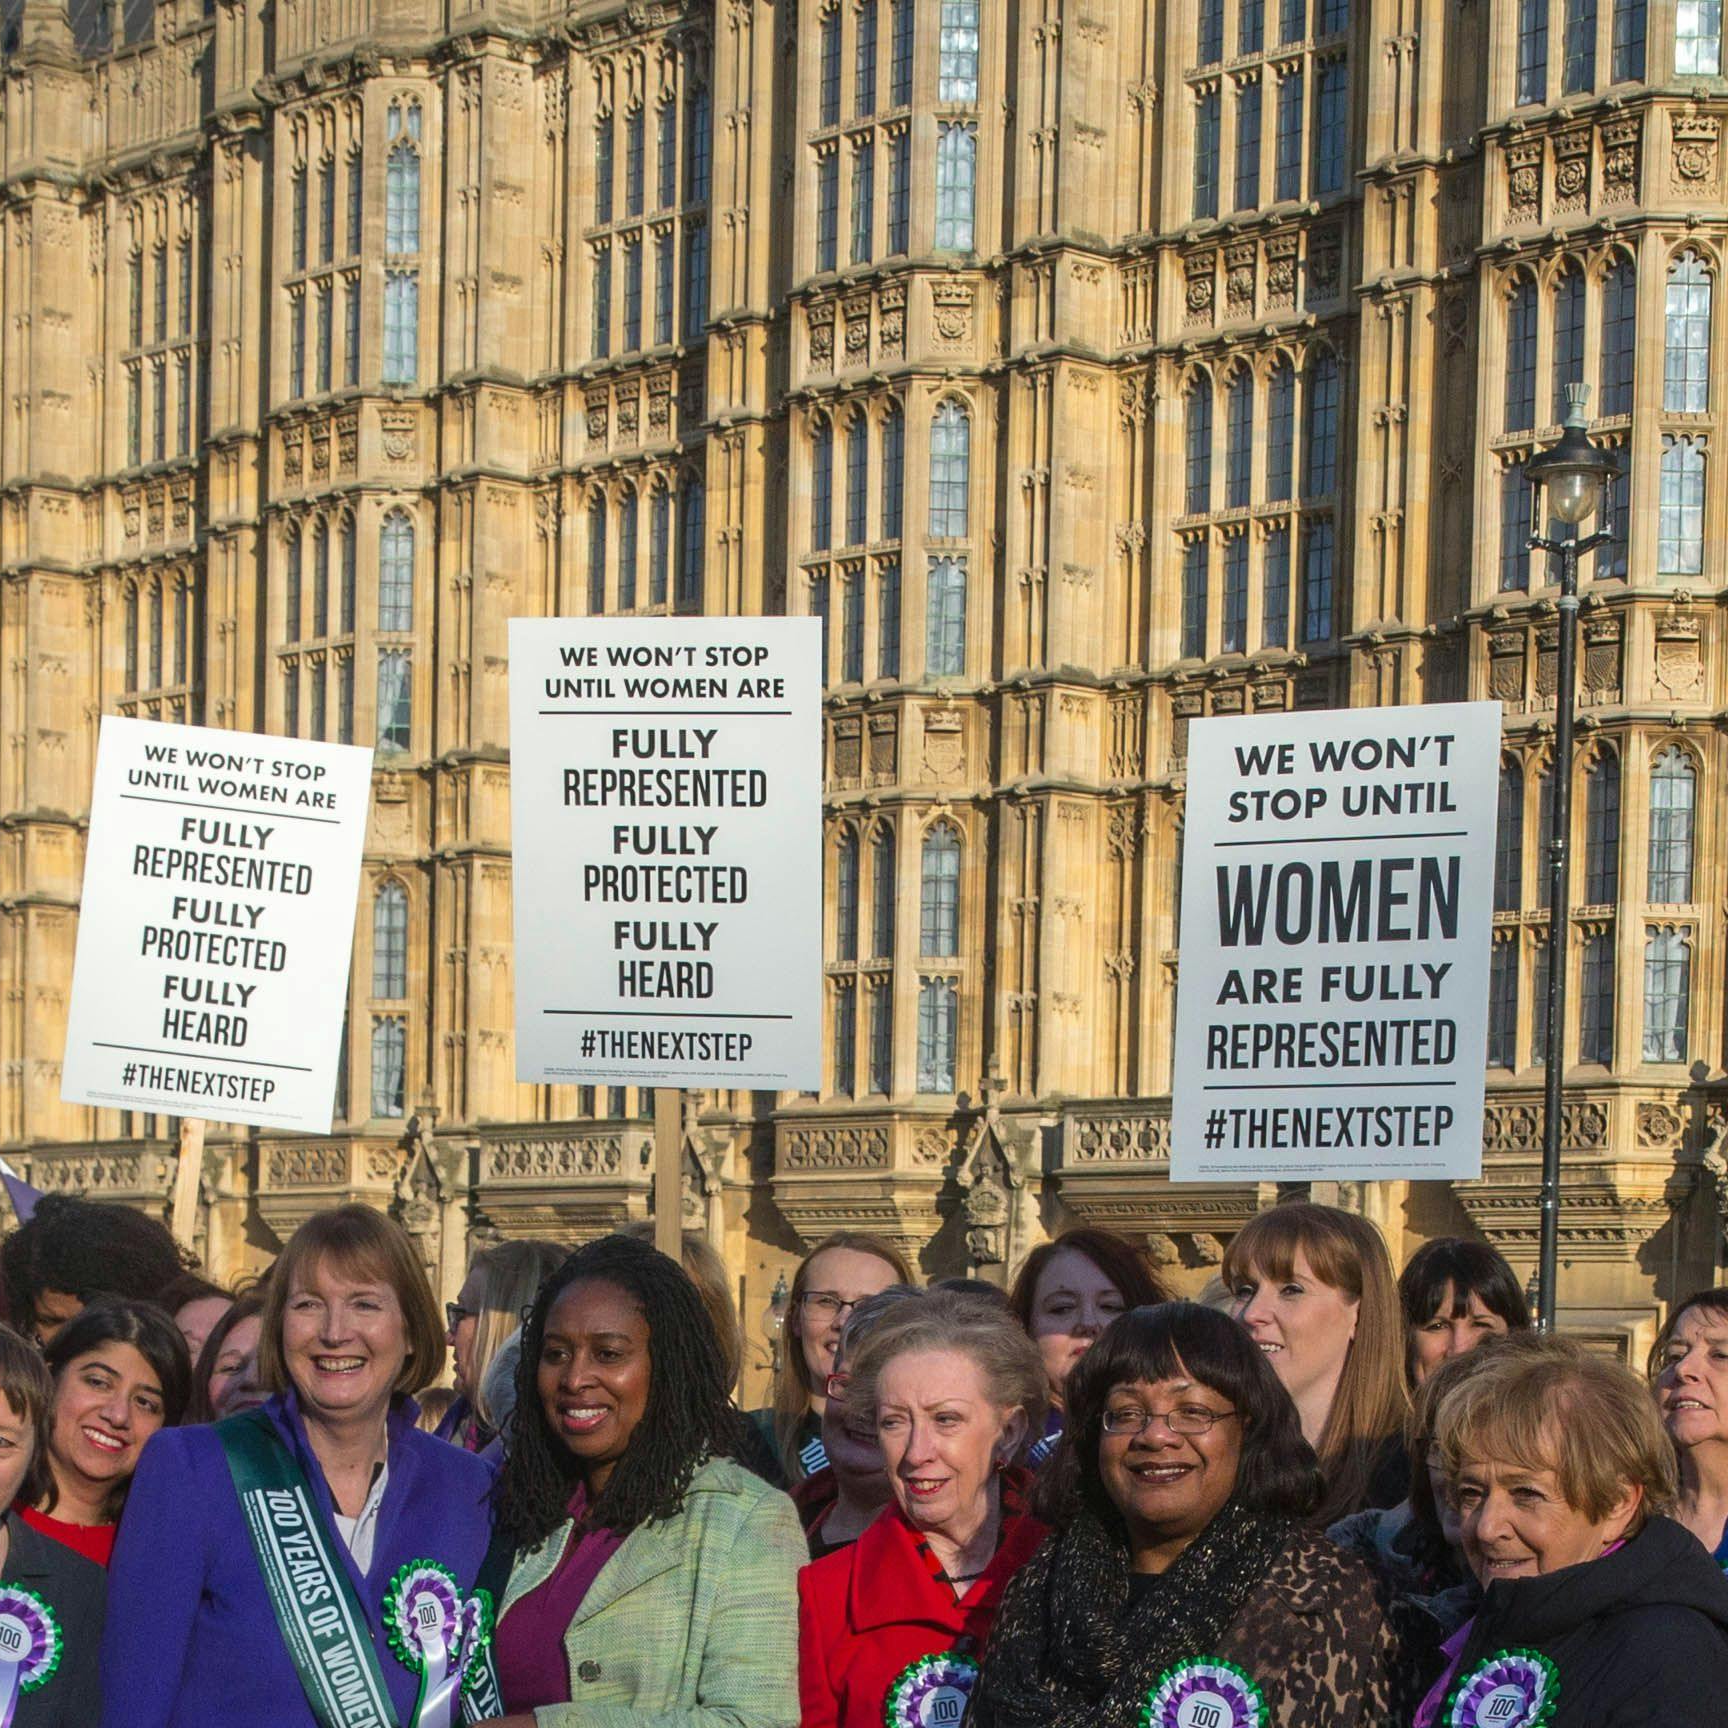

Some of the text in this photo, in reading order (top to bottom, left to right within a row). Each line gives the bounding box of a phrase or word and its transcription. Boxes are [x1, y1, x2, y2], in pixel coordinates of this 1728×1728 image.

[559, 646, 769, 667] WE WON'T STOP
[545, 678, 785, 699] UNTIL WOMEN ARE
[612, 729, 718, 759] FULLY
[1235, 735, 1455, 777] WE WON'T
[145, 745, 326, 782] WE WON'T STOP
[128, 769, 336, 809] UNTIL WOMEN ARE
[563, 769, 767, 808] REPRESENTED
[1228, 782, 1457, 823] STOP UNTIL
[181, 818, 275, 850] FULLY
[613, 826, 718, 855] FULLY
[133, 845, 313, 895] REPRESENTED
[583, 865, 748, 904] PROTECTED
[172, 897, 266, 929] FULLY
[1216, 855, 1461, 947] WOMEN
[141, 926, 287, 972] PROTECTED
[614, 921, 718, 951] FULLY
[163, 975, 257, 1008] FULLY
[618, 961, 714, 999] HEARD
[1216, 963, 1453, 1005] ARE FULLY
[162, 1009, 248, 1047] HEARD
[581, 1030, 752, 1061] #THENEXTSTEP
[1206, 1019, 1457, 1070] REPRESENTED
[122, 1062, 275, 1103] #THENEXTSTEP
[1204, 1105, 1454, 1149] #THENEXTSTEP
[266, 1488, 302, 1529] 100
[280, 1530, 332, 1606] YEARS
[308, 1607, 345, 1639] OF
[419, 1605, 437, 1625] 100
[933, 1699, 959, 1721] 100
[1191, 1704, 1220, 1728] 100
[1488, 1697, 1516, 1716] 100
